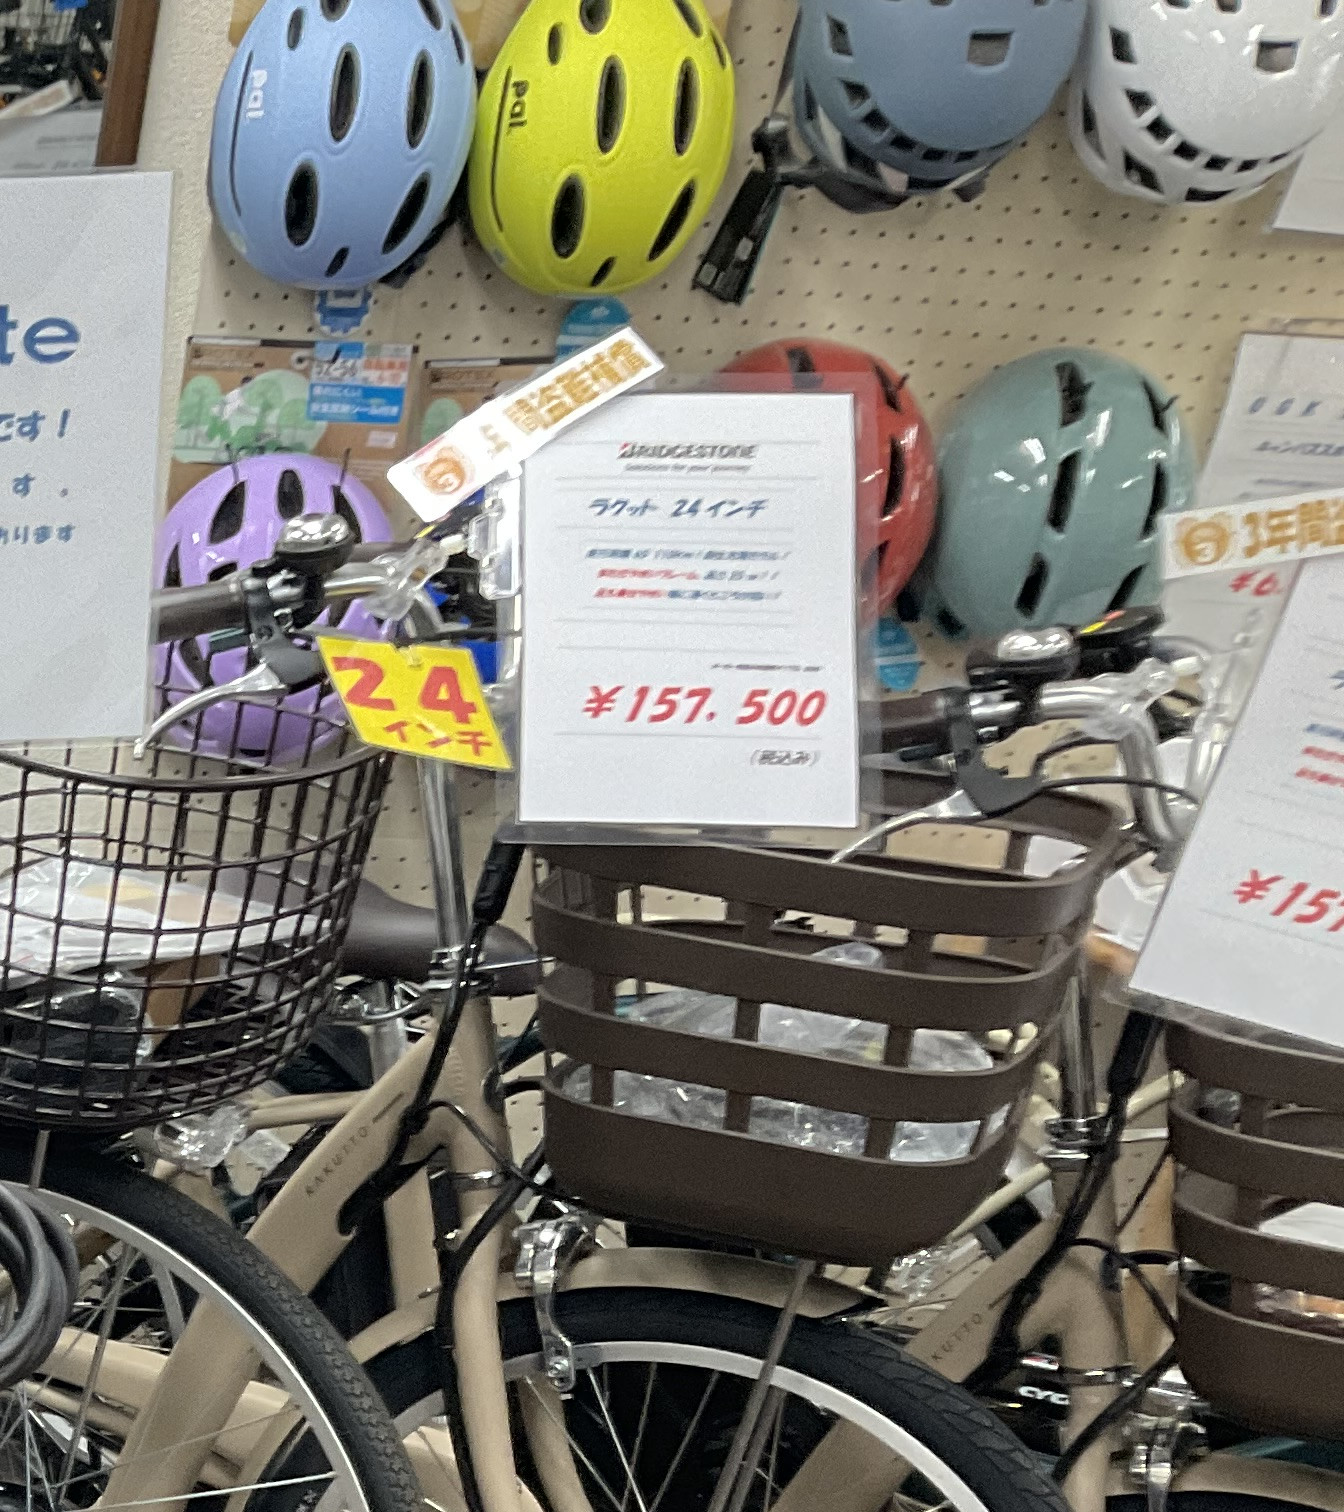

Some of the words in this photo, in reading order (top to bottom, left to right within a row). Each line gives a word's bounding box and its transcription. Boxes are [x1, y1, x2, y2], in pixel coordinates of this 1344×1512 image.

[509, 79, 530, 129] pal
[616, 441, 759, 459] BRIDGESTONE
[384, 719, 493, 758] インチ
